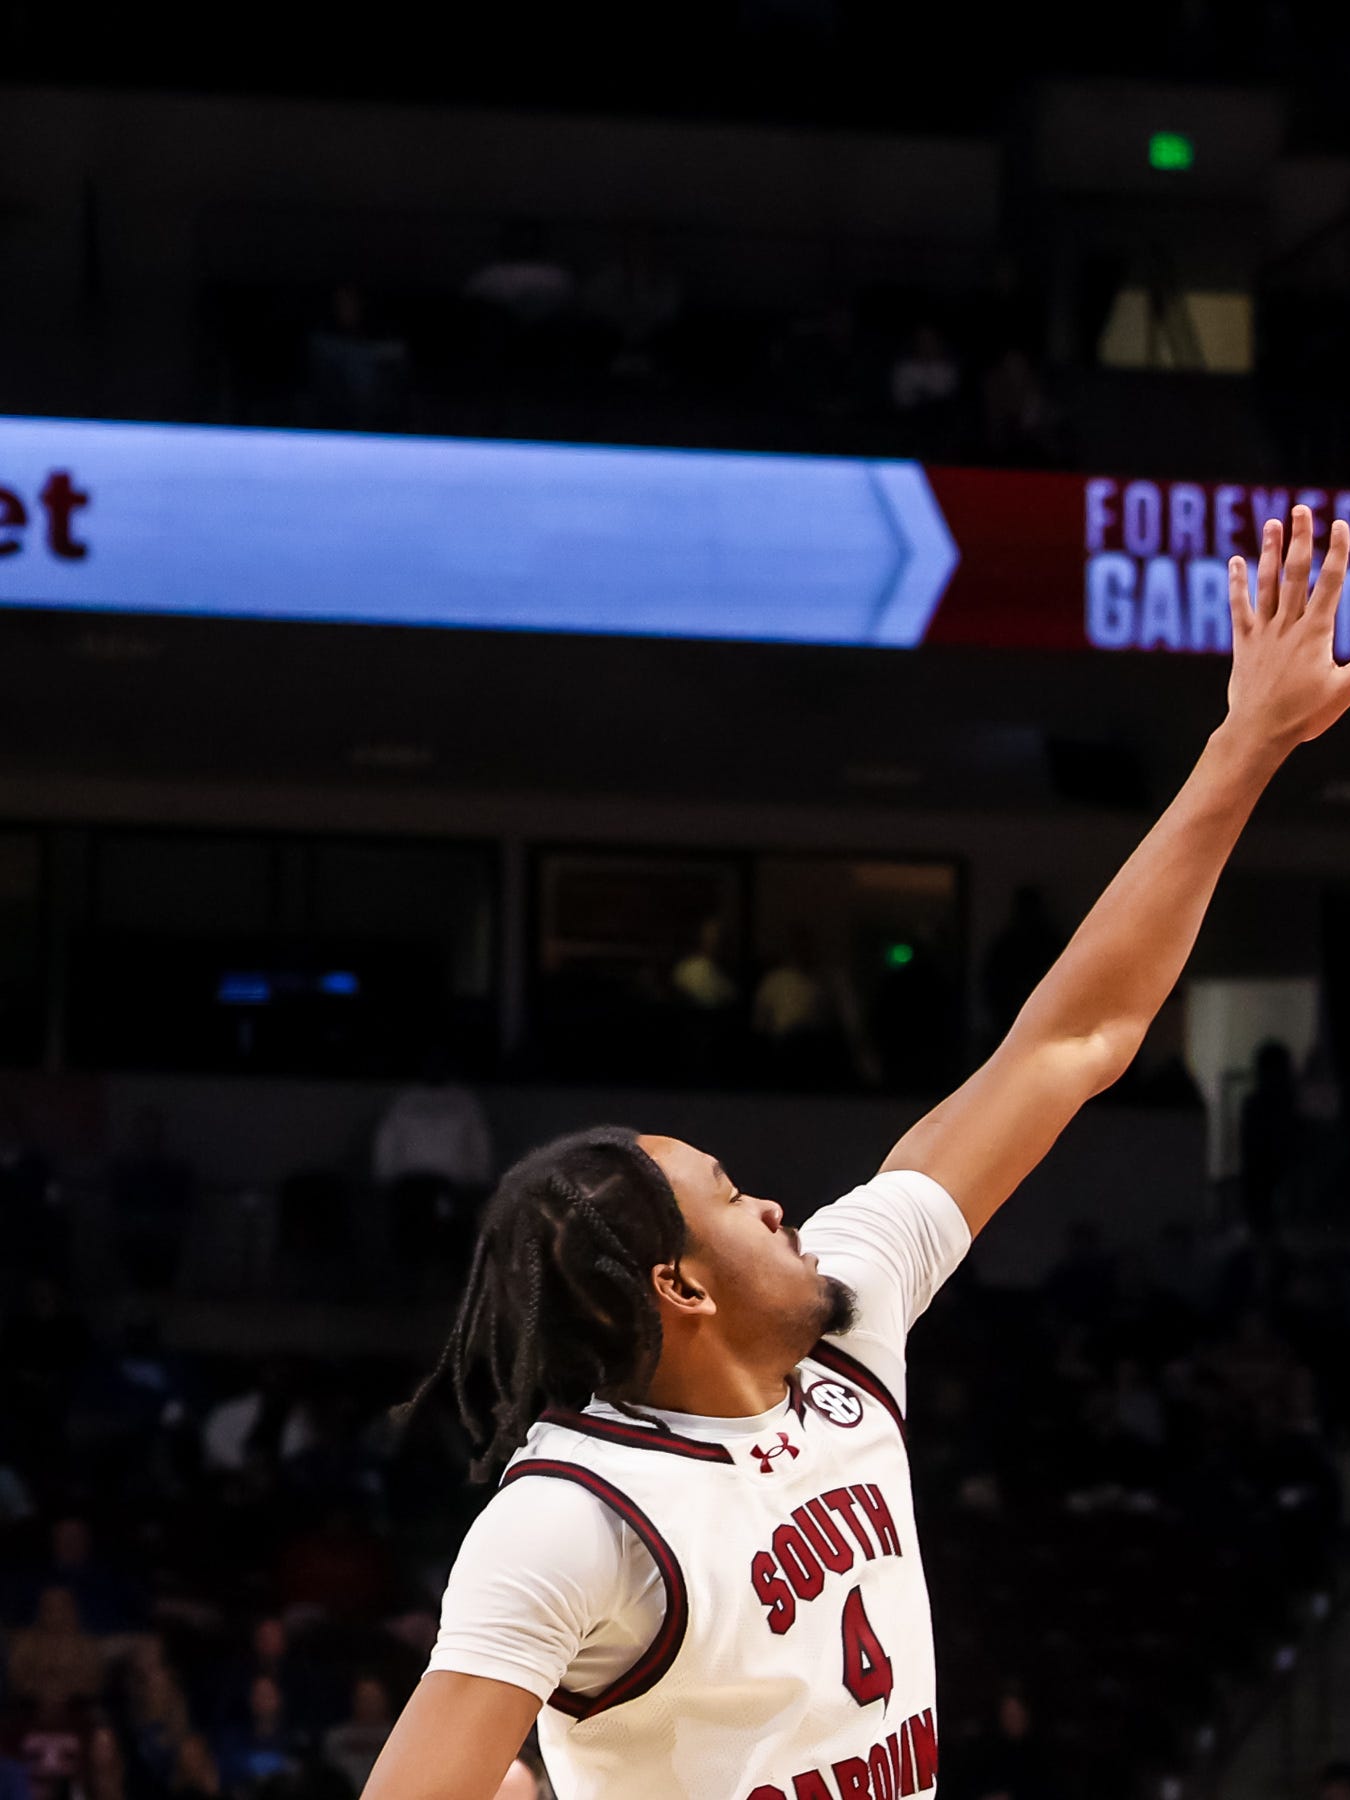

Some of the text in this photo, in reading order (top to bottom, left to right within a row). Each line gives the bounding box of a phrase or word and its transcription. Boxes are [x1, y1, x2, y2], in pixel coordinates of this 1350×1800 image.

[811, 1383, 861, 1424] SEC
[751, 1484, 902, 1635] SOUTH
[842, 1584, 893, 1719] 4
